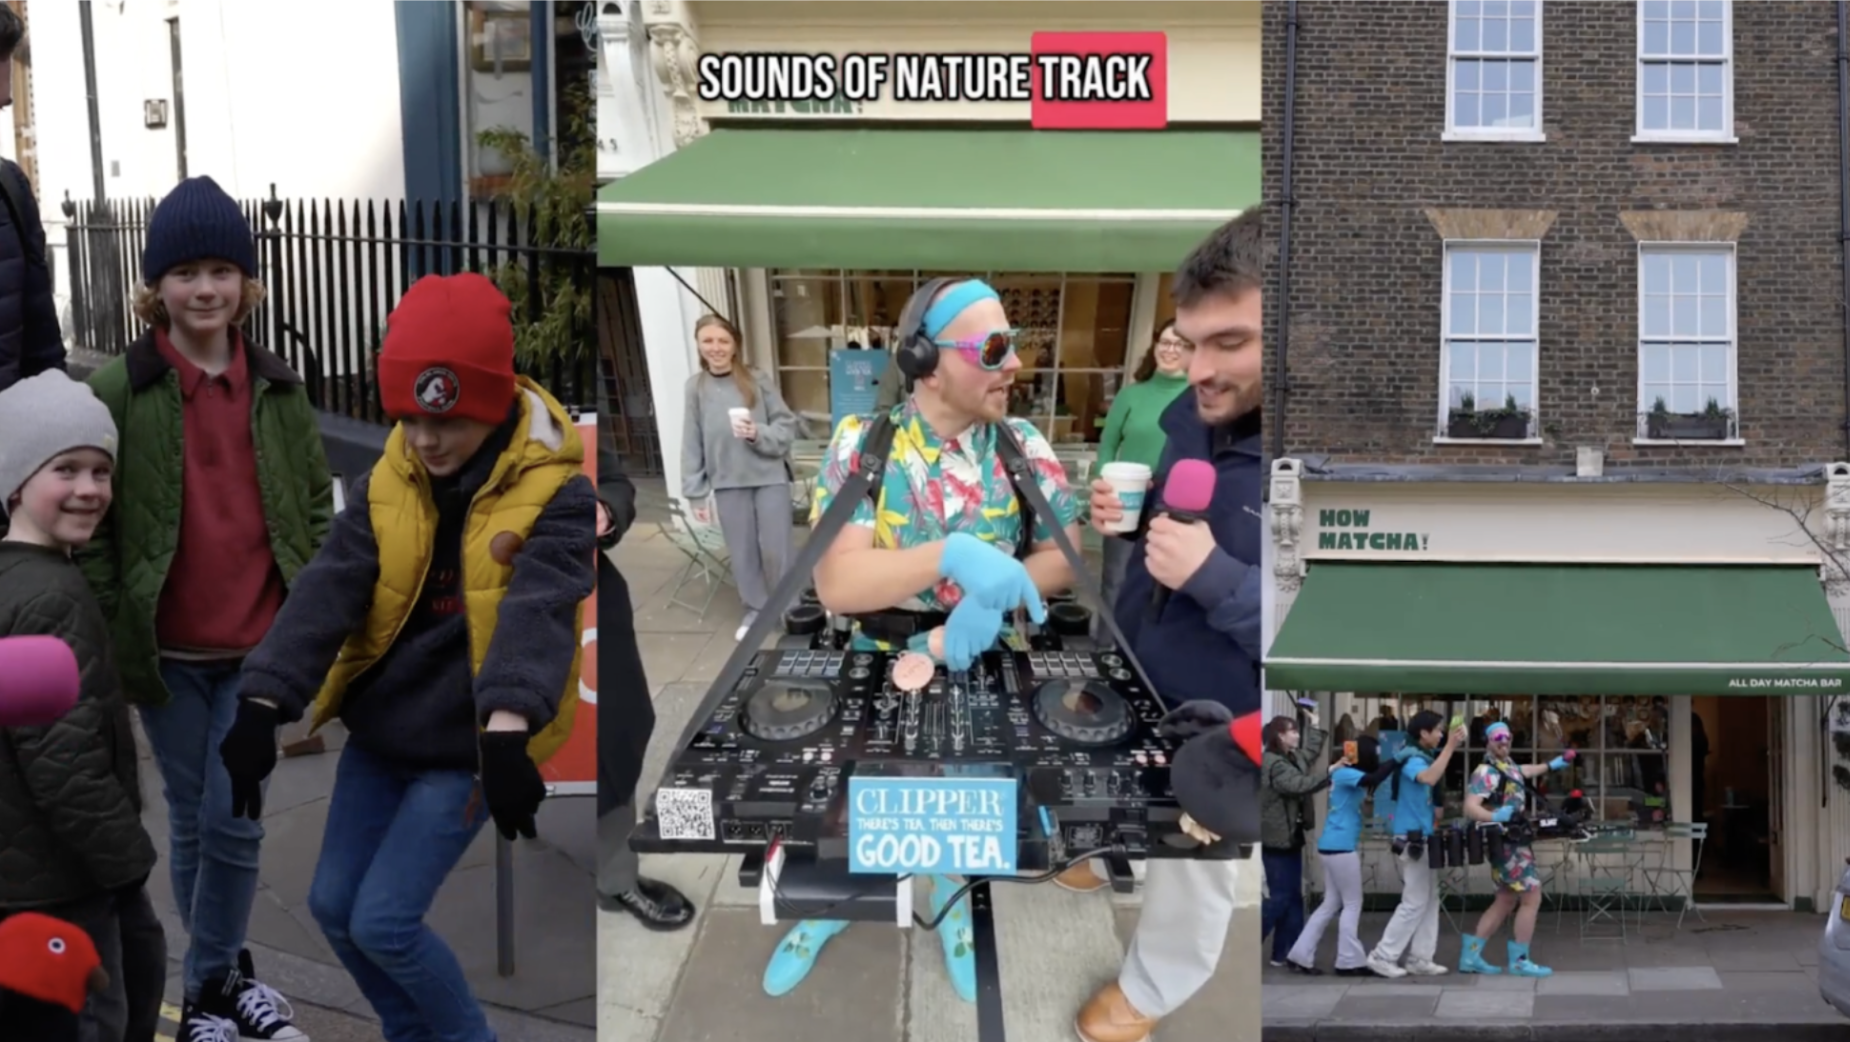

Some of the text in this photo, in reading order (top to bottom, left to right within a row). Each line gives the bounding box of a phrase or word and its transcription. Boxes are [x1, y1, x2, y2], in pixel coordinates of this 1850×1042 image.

[1319, 509, 1370, 527] HOW
[1318, 532, 1429, 551] MATCHA!
[1729, 678, 1842, 688] ALL DAY MATCHA BAR
[856, 788, 1003, 816] CLIPPER
[857, 818, 899, 831] THERE'S
[929, 819, 957, 831] THEN
[961, 819, 1003, 832] THERE'S
[856, 833, 1011, 869] GOOD TEA.
